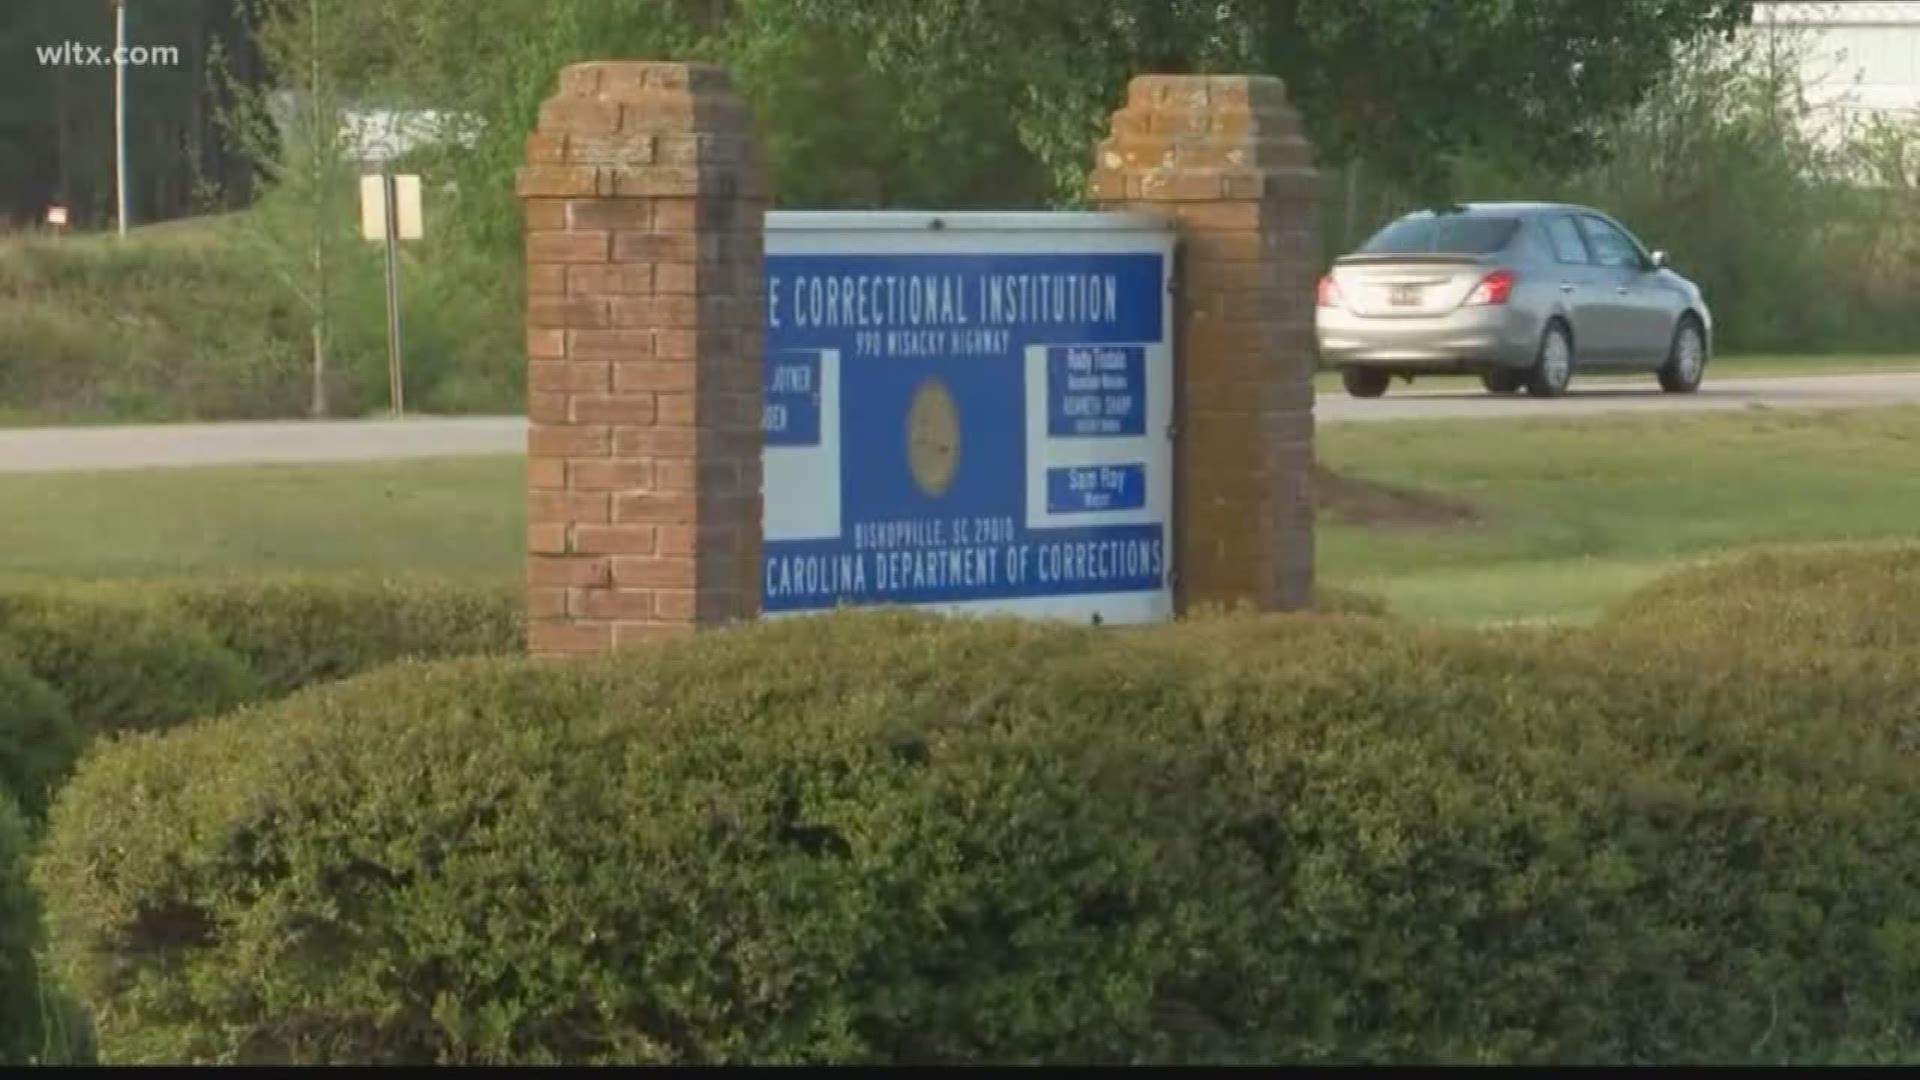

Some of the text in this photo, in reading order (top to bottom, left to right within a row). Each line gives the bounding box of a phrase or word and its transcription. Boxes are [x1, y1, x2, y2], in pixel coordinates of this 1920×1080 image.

[794, 275, 967, 326] CORRECTIONAL
[980, 274, 1117, 324] INSTITUTION
[951, 329, 1009, 355] HIGHWAY
[953, 517, 968, 546] SC
[767, 539, 1162, 596] CAROLINA DEPARTMENT OF CORRECTIONS
